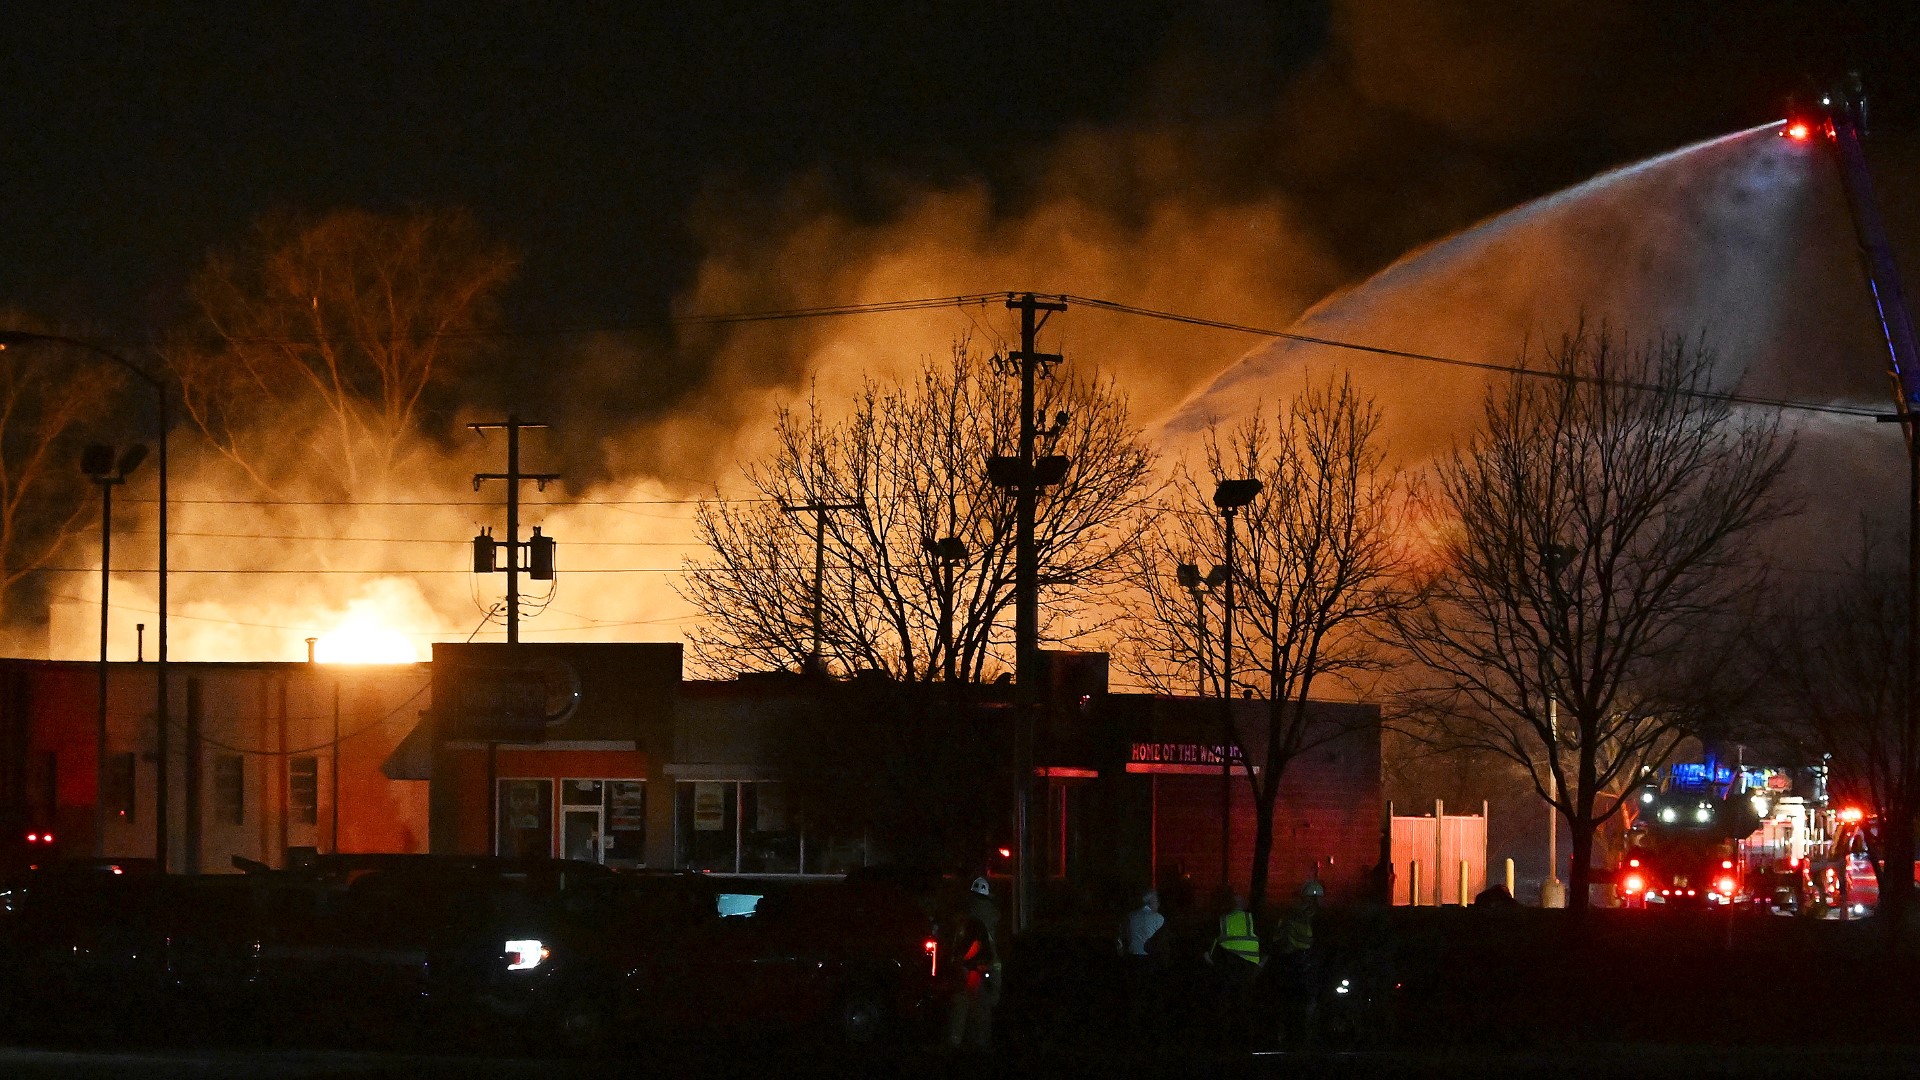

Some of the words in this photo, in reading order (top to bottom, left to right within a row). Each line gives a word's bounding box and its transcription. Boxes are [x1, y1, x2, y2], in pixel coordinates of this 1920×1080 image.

[1131, 743, 1160, 761] HOME
[1163, 744, 1176, 761] OF
[1178, 744, 1197, 762] THE
